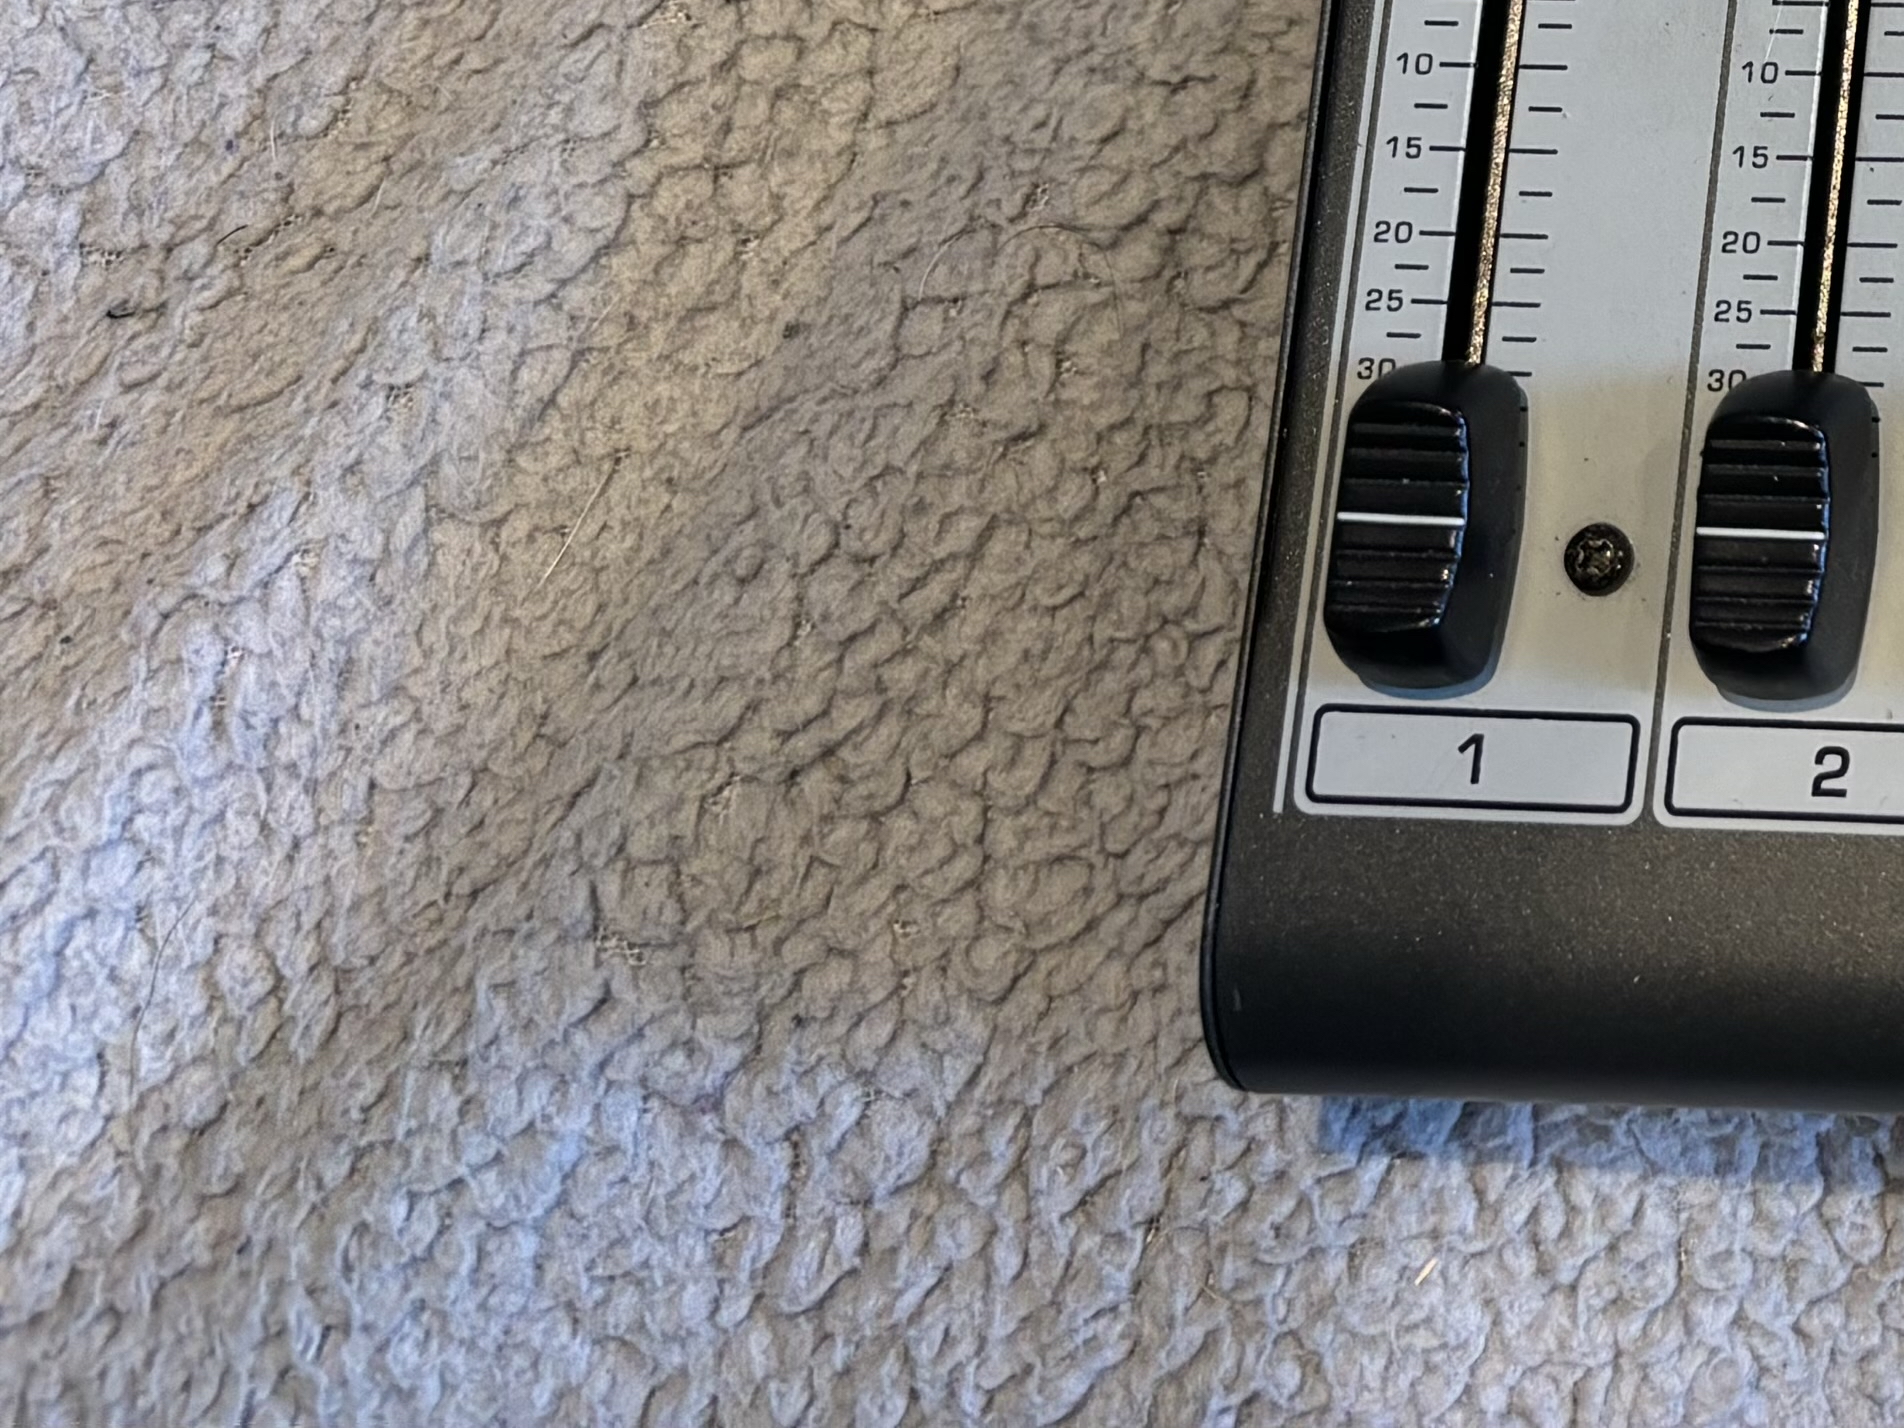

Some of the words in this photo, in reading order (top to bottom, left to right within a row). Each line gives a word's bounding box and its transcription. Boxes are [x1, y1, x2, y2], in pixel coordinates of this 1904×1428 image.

[1386, 136, 1422, 160] 15
[1373, 222, 1413, 244] 20
[1365, 290, 1404, 312] 25
[1457, 734, 1486, 784] 1
[1811, 746, 1850, 797] 2
